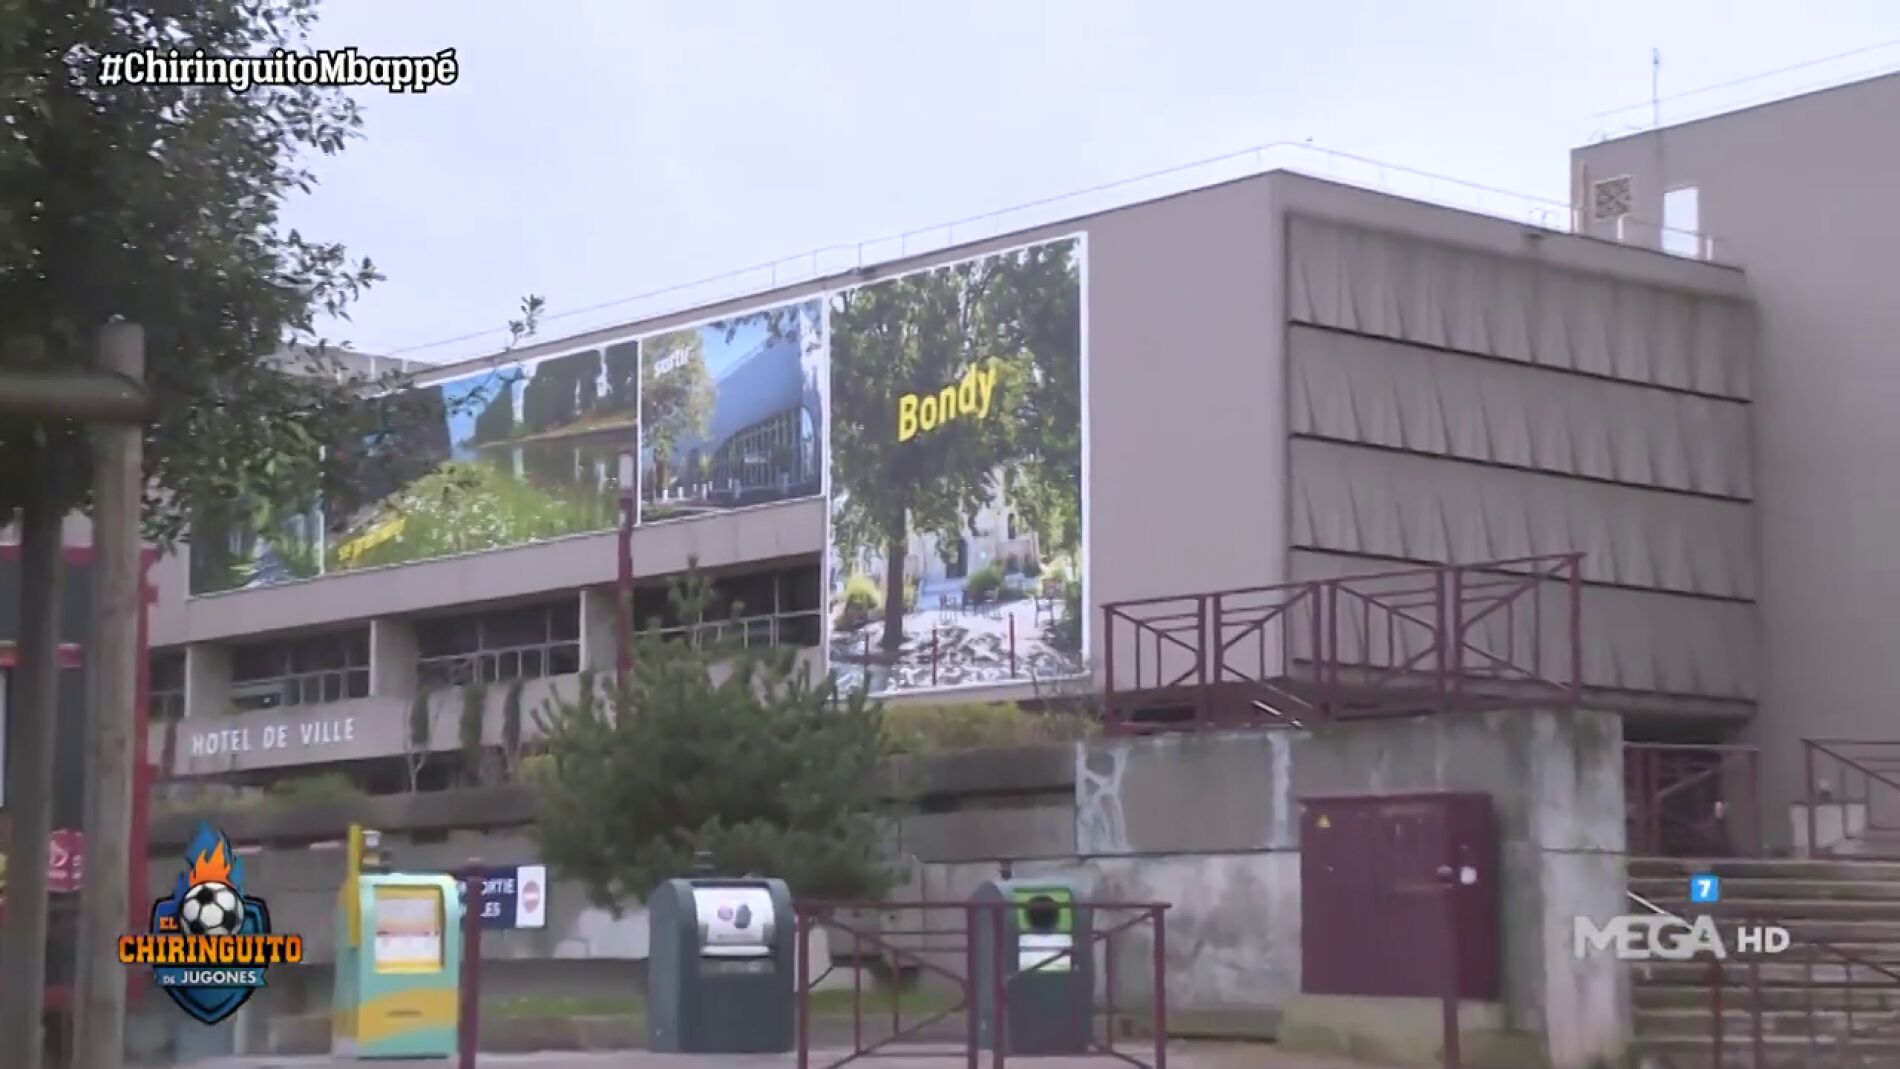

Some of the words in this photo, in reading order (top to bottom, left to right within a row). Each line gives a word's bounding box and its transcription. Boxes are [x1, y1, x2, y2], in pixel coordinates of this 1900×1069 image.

[898, 362, 997, 442] Bondy
[192, 728, 250, 755] HOTEL
[263, 724, 288, 749] DE
[300, 718, 355, 745] VILLE
